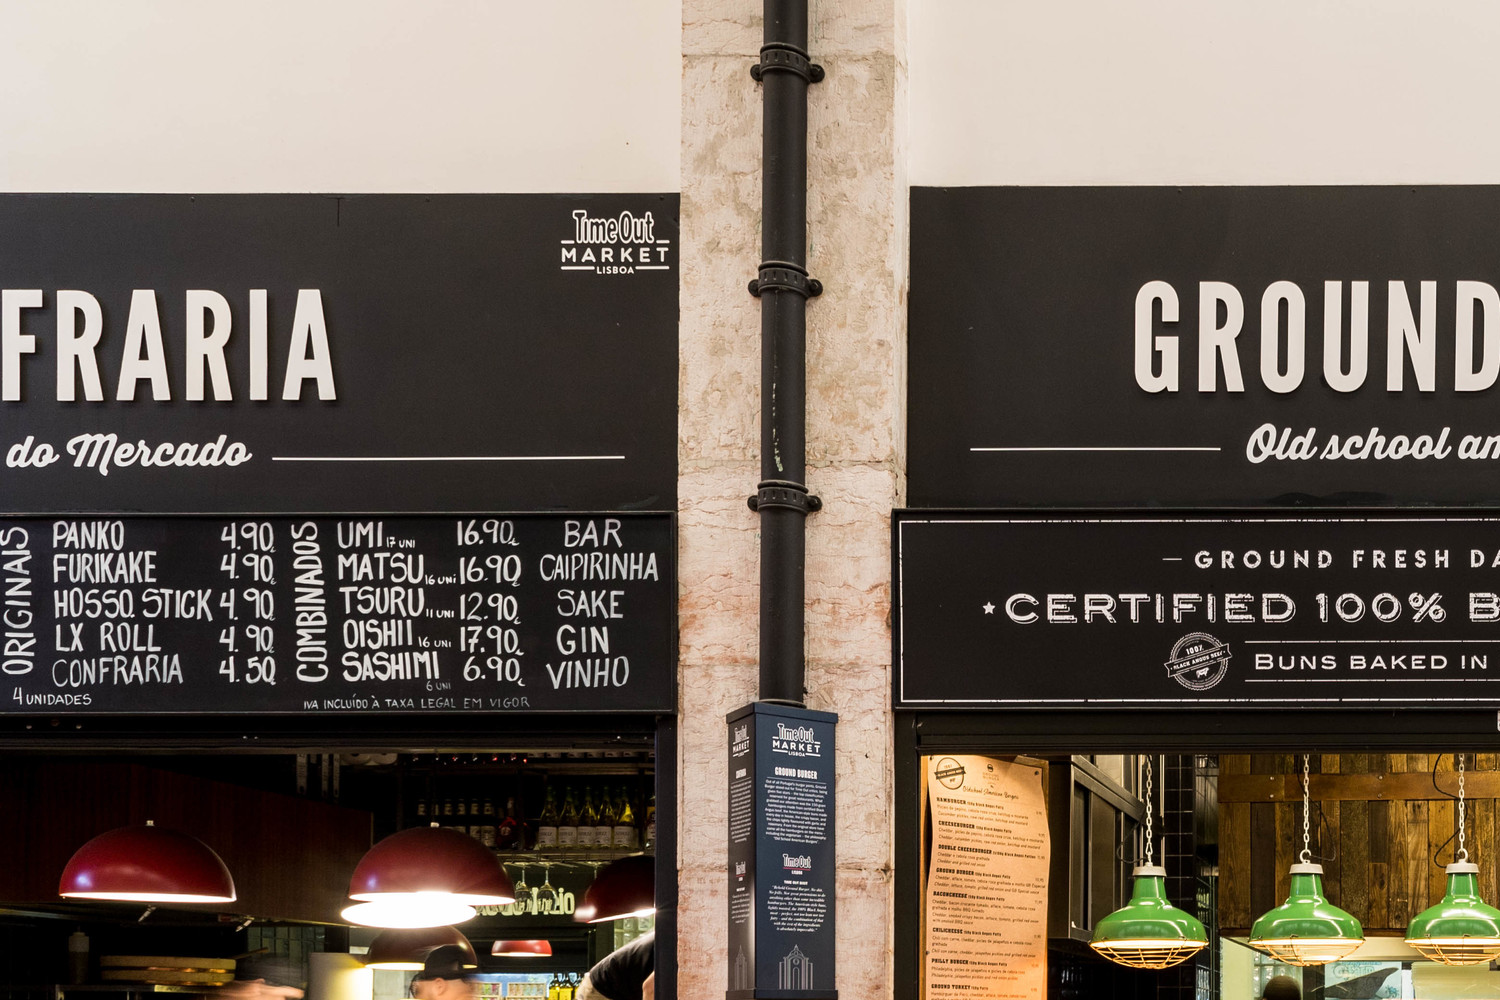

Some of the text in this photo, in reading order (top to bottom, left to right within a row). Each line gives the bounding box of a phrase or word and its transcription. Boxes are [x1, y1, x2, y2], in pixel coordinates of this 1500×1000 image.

[561, 247, 669, 262] MARKET
[596, 266, 635, 274] LISBOA
[1, 288, 337, 402] FRARIA
[5, 433, 253, 477] do Mercado
[1245, 422, 1320, 464] Old
[1320, 426, 1453, 462] school
[52, 520, 125, 550] PANKO
[337, 521, 416, 549] UMI 17 UNI
[564, 519, 623, 548] BAR
[53, 551, 157, 584] FURIKAKE
[337, 552, 425, 584] MATSU
[425, 574, 436, 586] 16
[540, 552, 659, 582] CAIPIRINHA
[1194, 549, 1333, 569] GROUND
[1352, 549, 1450, 569] FRESH
[0, 526, 37, 675] ORIGINAIS
[141, 588, 214, 622] STICK
[291, 521, 329, 683] COMBINADOS
[339, 586, 425, 617] TSURU
[436, 609, 455, 619] UNI
[557, 589, 625, 619] SAKE
[1004, 592, 1297, 625] CERTIFIED
[1315, 592, 1447, 624] 100%
[55, 621, 162, 652] LX ROLL
[343, 619, 413, 650] OISHII
[418, 636, 431, 648] 16
[556, 624, 610, 656] GIN
[1173, 650, 1224, 670] BLACK ANGUS BEEF
[1185, 645, 1204, 655] 100%
[1350, 653, 1448, 671] BAKED
[1460, 653, 1490, 670] IN
[52, 653, 184, 688] CONFRARIA
[341, 651, 441, 682] SASHIMI
[546, 656, 630, 690] VINHO
[13, 687, 92, 706] 4 UNIDADES
[426, 680, 451, 692] 6 UNI
[303, 693, 531, 710] IVA INCLUÍDO À TAXA LEGAL EM VIGOR
[772, 740, 821, 754] MARKET
[774, 766, 818, 780] GROUND BURGER
